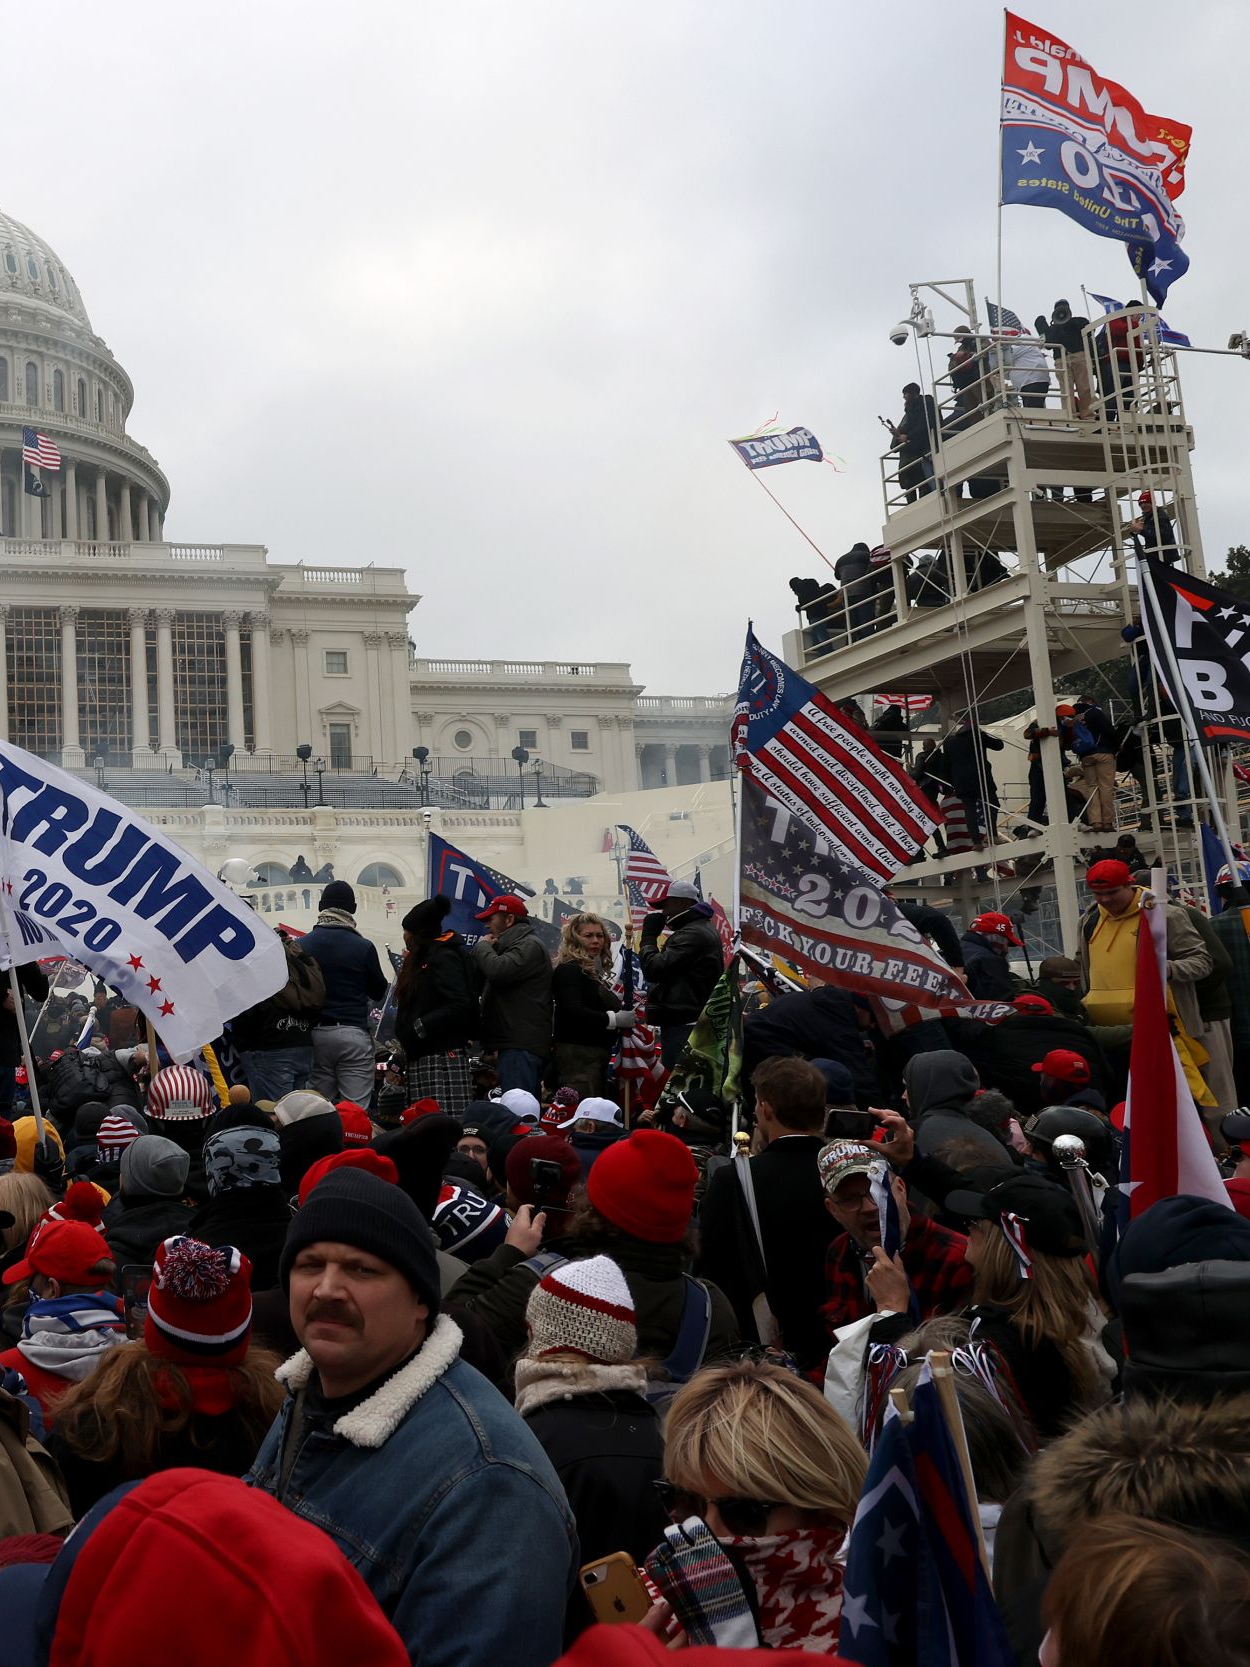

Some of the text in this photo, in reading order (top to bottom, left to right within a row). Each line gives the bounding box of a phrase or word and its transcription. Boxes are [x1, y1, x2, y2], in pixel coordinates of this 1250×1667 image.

[740, 428, 814, 457] TRUMP
[770, 660, 785, 694] BECOMES
[749, 709, 769, 721] DUTY
[790, 727, 817, 754] armed
[817, 751, 839, 770] and
[876, 809, 897, 829] But
[893, 827, 916, 853] They
[816, 717, 838, 734] free
[834, 732, 867, 760] people
[865, 758, 891, 782] ought
[888, 780, 903, 795] not
[915, 811, 928, 827] Be
[770, 781, 797, 807] status
[797, 806, 807, 818] of
[770, 745, 802, 773] should
[800, 771, 822, 792] have
[819, 791, 856, 830] sufficient
[854, 827, 875, 848] arms
[875, 846, 898, 868] And
[18, 868, 122, 953] 2020
[996, 923, 1006, 932] 45
[799, 936, 873, 976] YOUR
[822, 1144, 870, 1166] TRUMP
